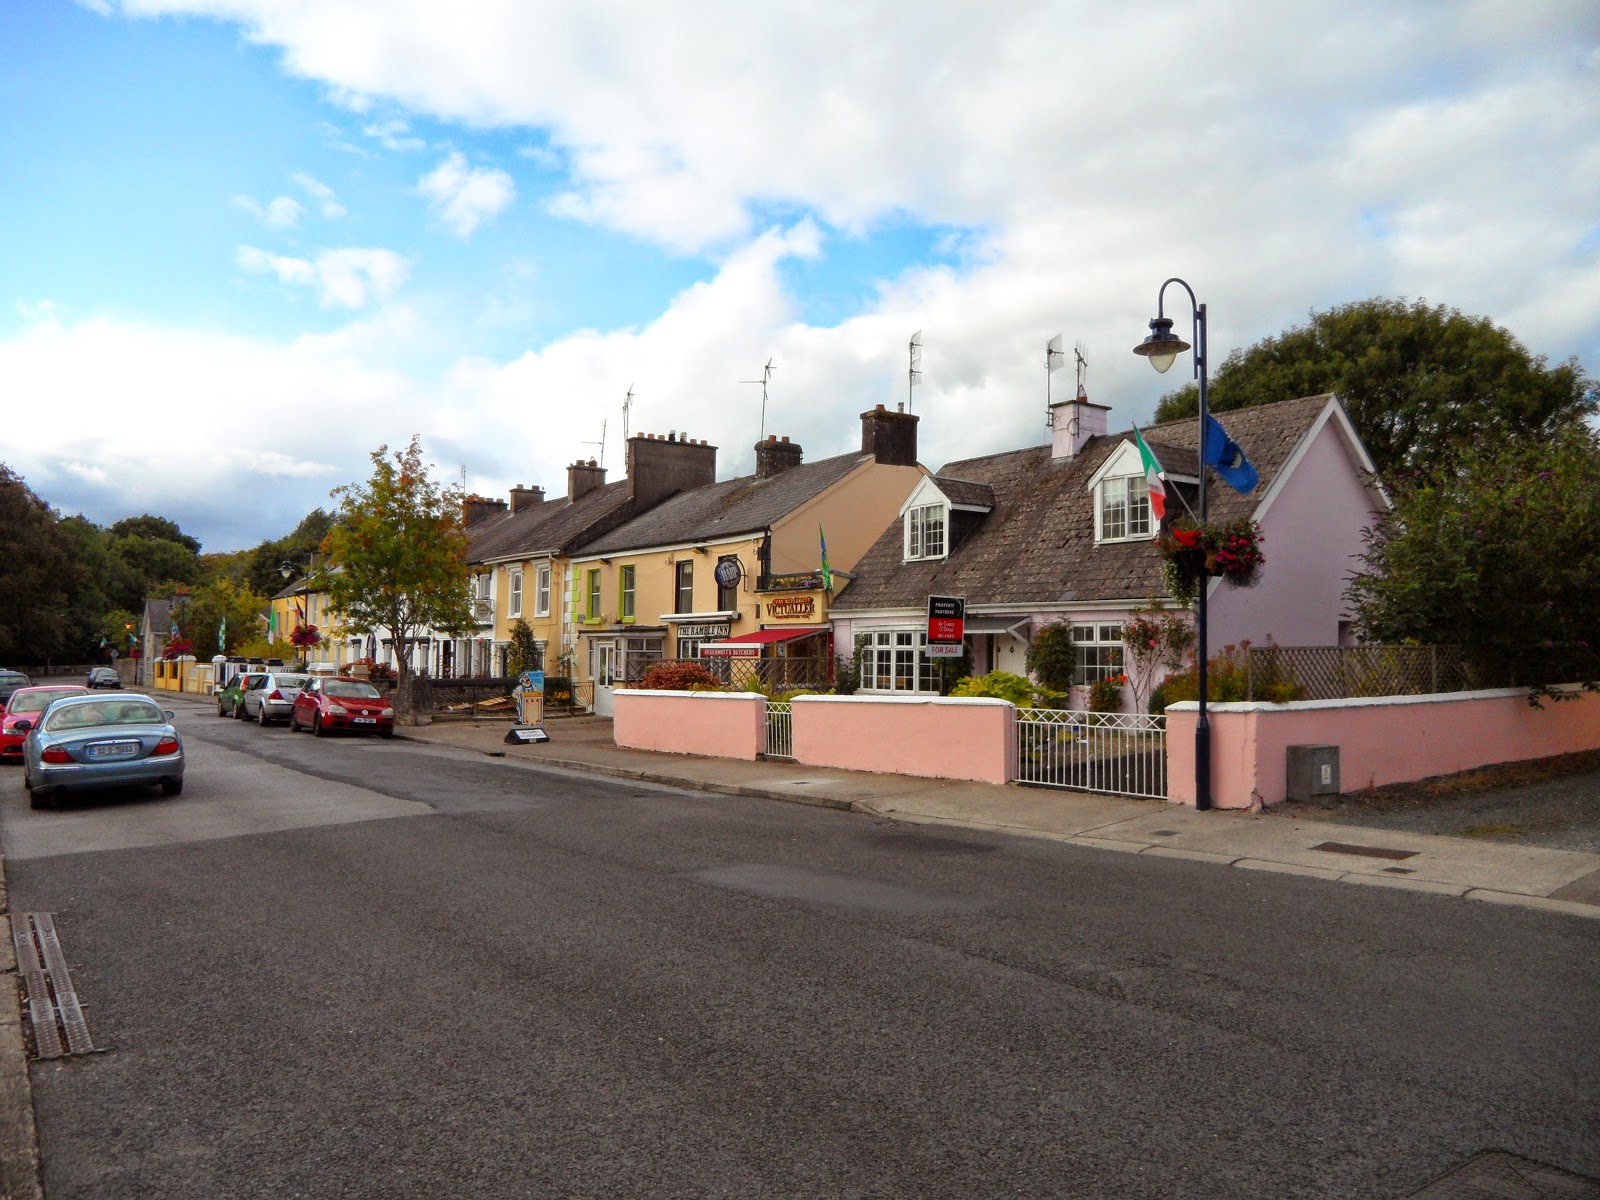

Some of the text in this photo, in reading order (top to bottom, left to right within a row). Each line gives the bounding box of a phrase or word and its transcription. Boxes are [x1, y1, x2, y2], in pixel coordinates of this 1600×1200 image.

[766, 603, 815, 616] VICTUALLER
[679, 624, 729, 636] THE RAMBLE INN
[733, 648, 755, 656] BUTCHERS
[945, 646, 958, 654] SALE
